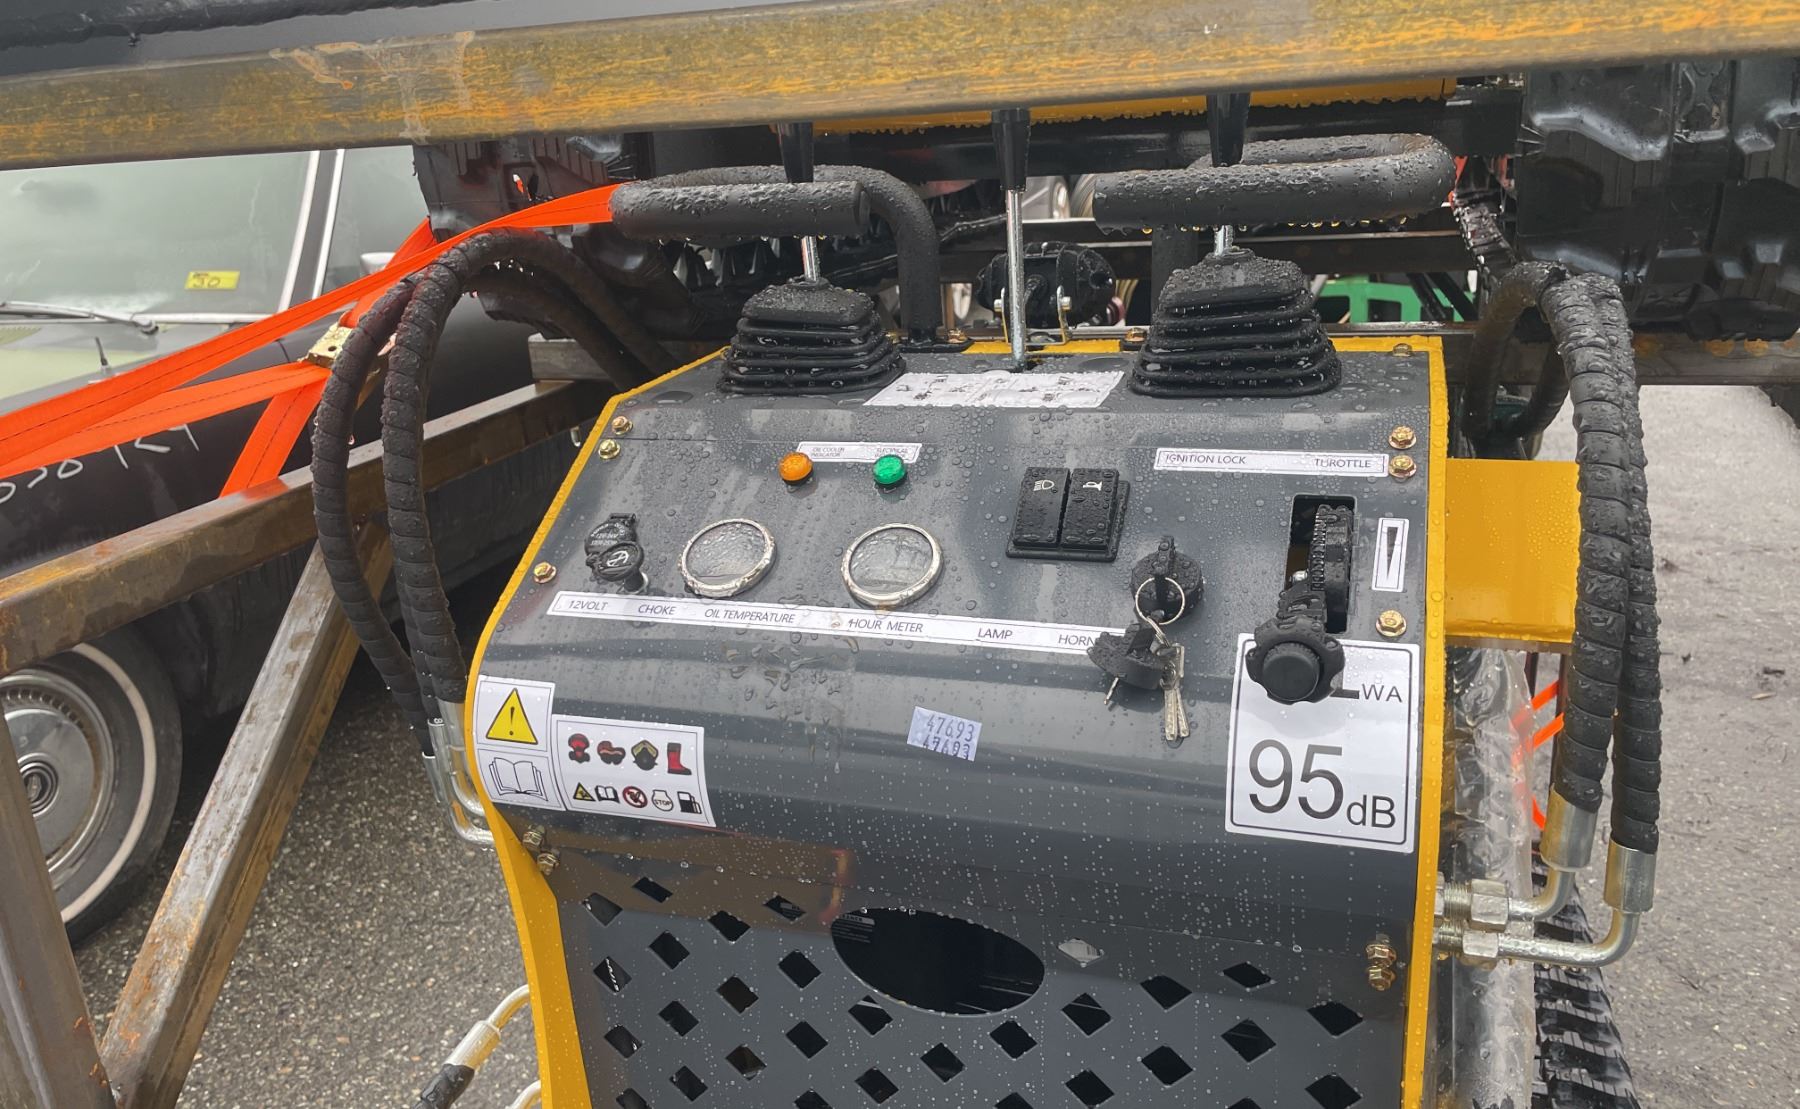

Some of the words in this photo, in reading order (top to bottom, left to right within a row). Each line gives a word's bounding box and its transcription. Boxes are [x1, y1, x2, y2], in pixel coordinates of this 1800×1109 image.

[1165, 453, 1214, 464] IGNITION
[1217, 455, 1247, 465] LOCK
[567, 600, 608, 611] 12VOLT
[638, 604, 677, 616] CHOKE
[704, 608, 722, 619] OIL
[722, 609, 796, 624] TEMPERATURE
[850, 618, 882, 630] HOUR
[886, 621, 924, 633] METER
[977, 628, 1013, 640] LAMP
[1058, 634, 1095, 646] HORN
[926, 714, 975, 743] 47693
[1248, 739, 1344, 820] 95
[1346, 794, 1396, 829] dB
